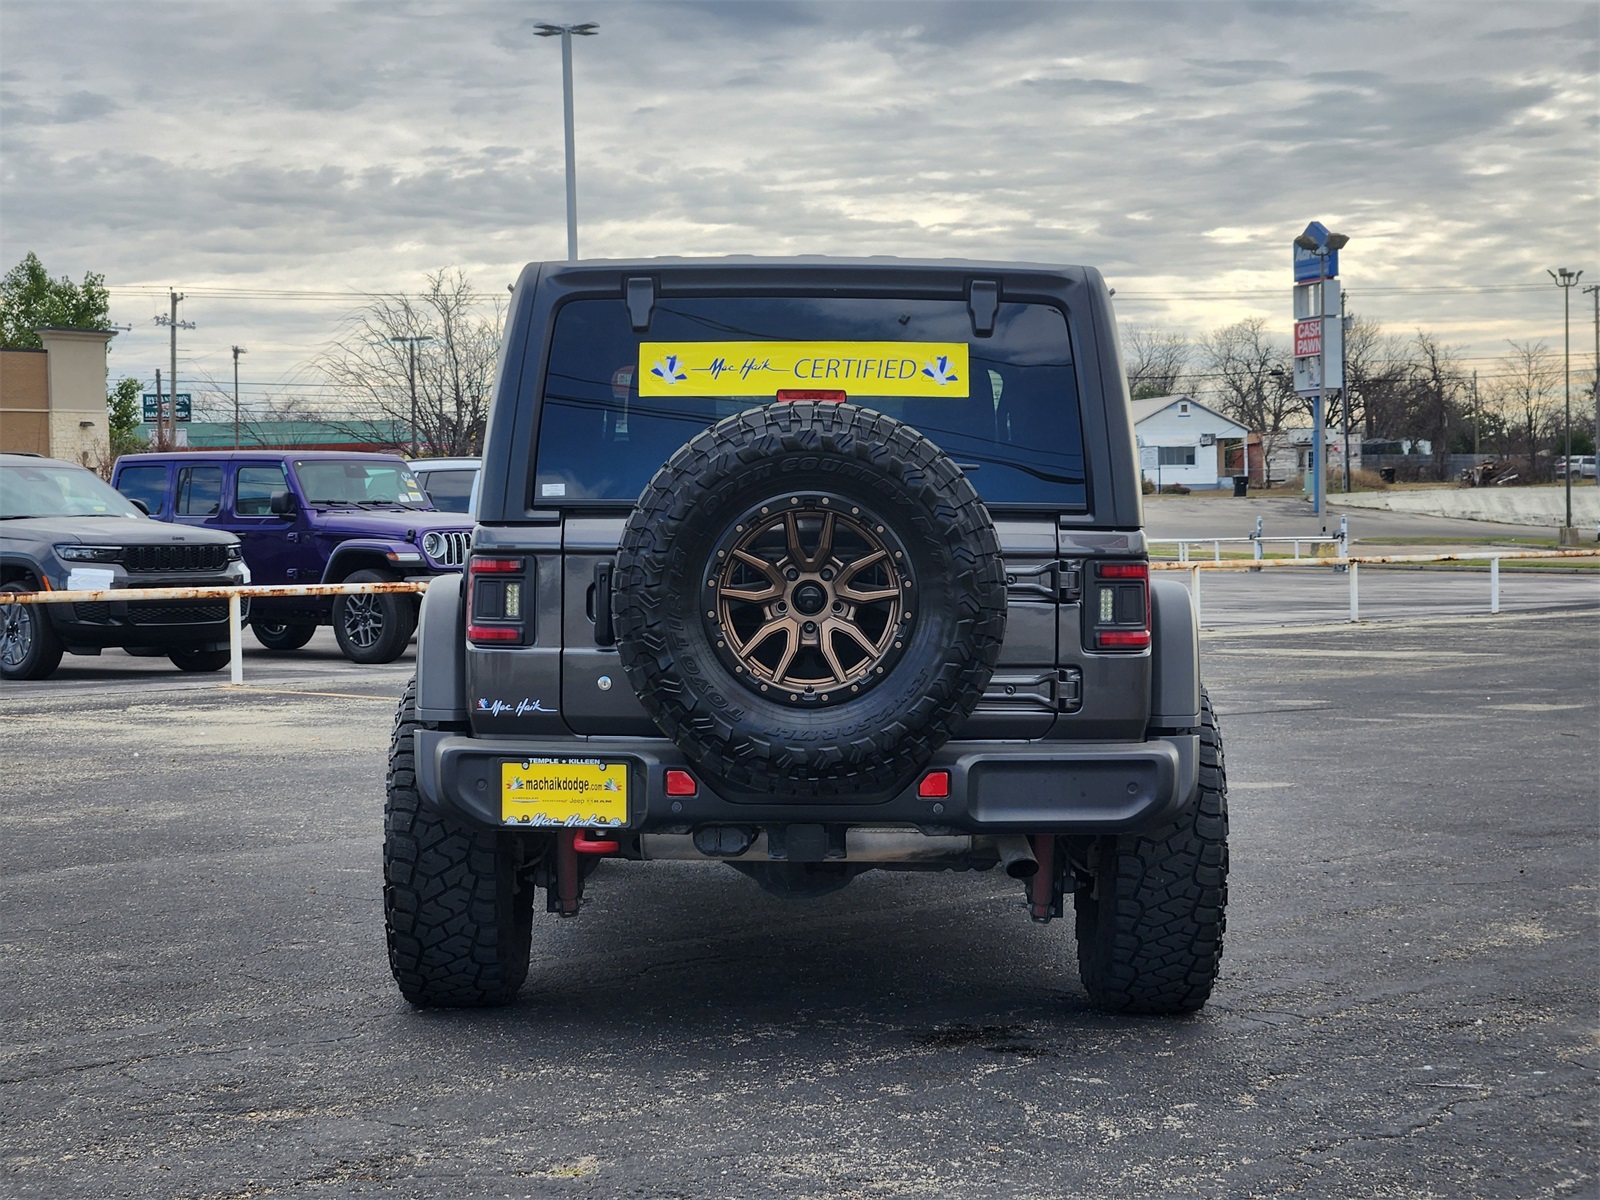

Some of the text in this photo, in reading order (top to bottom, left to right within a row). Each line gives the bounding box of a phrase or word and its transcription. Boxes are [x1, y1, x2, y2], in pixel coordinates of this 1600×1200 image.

[1297, 322, 1321, 339] CASH
[1297, 338, 1321, 354] PAWN
[699, 358, 917, 380] Mac Haik CERTIFIED
[780, 456, 914, 505] COUNTRY
[680, 653, 745, 723] TOYO
[484, 698, 550, 717] Mac Haik
[525, 776, 603, 794] machaikdodge.com
[519, 813, 610, 827] Mac Haik
